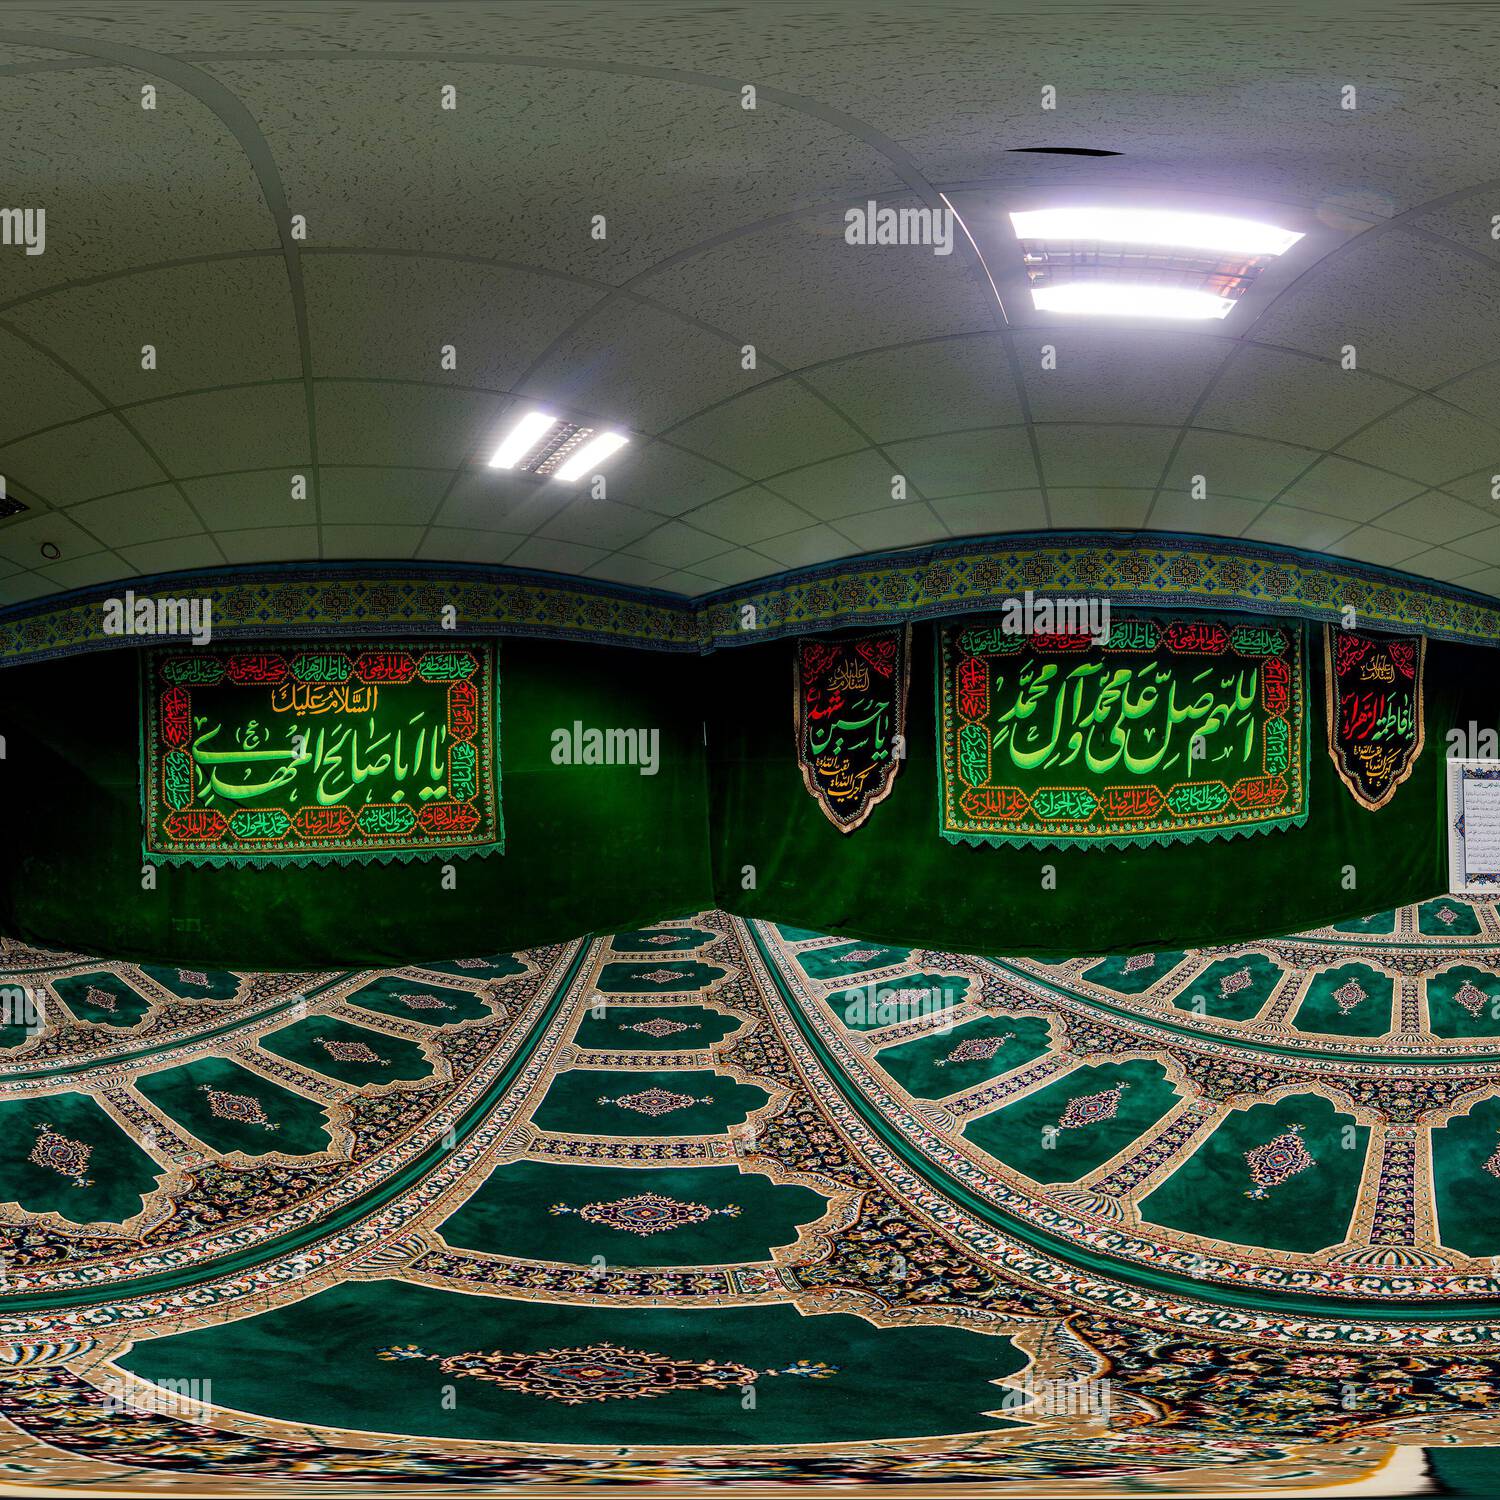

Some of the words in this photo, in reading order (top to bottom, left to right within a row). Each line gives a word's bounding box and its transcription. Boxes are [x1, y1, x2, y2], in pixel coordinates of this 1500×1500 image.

[310, 685, 378, 714] السلام
[1069, 790, 1097, 818] محمد
[263, 811, 291, 838] محمد
